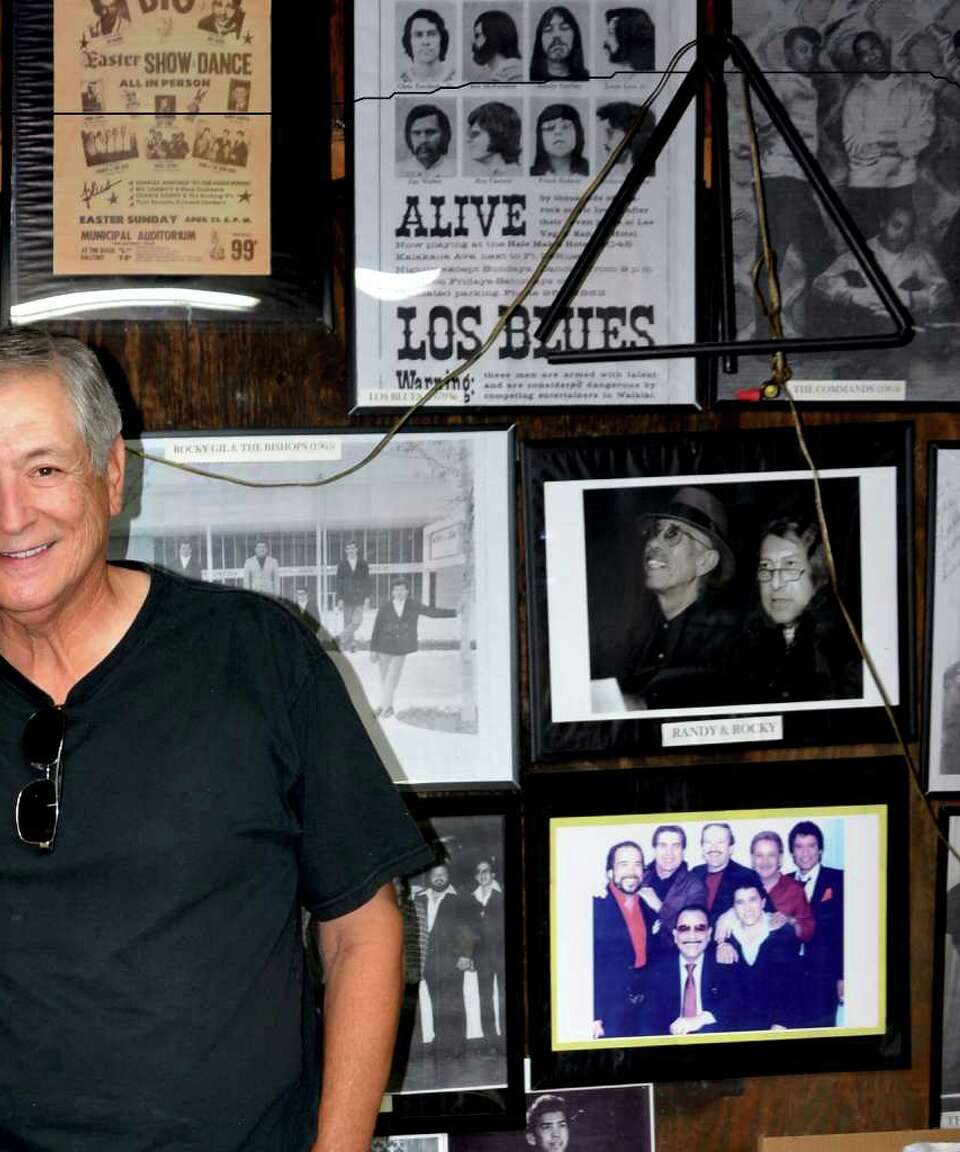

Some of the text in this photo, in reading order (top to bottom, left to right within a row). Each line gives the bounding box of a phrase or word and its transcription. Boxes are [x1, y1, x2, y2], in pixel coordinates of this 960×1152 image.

[80, 51, 252, 76] Easter SHOW DANCE
[120, 79, 211, 88] ALL IN PERSON
[79, 215, 124, 225] EASTER
[127, 215, 178, 225] SUNDAY
[395, 195, 526, 237] ALIVE
[80, 230, 196, 241] MUNICIPAL AUDITORIUM
[396, 305, 482, 361] LOS
[816, 384, 874, 394] COMMANDS
[174, 445, 209, 455] ROCKY
[241, 443, 261, 453] THE
[264, 441, 308, 452] BISHOPS
[672, 722, 777, 739] RANDY & ROCKY
